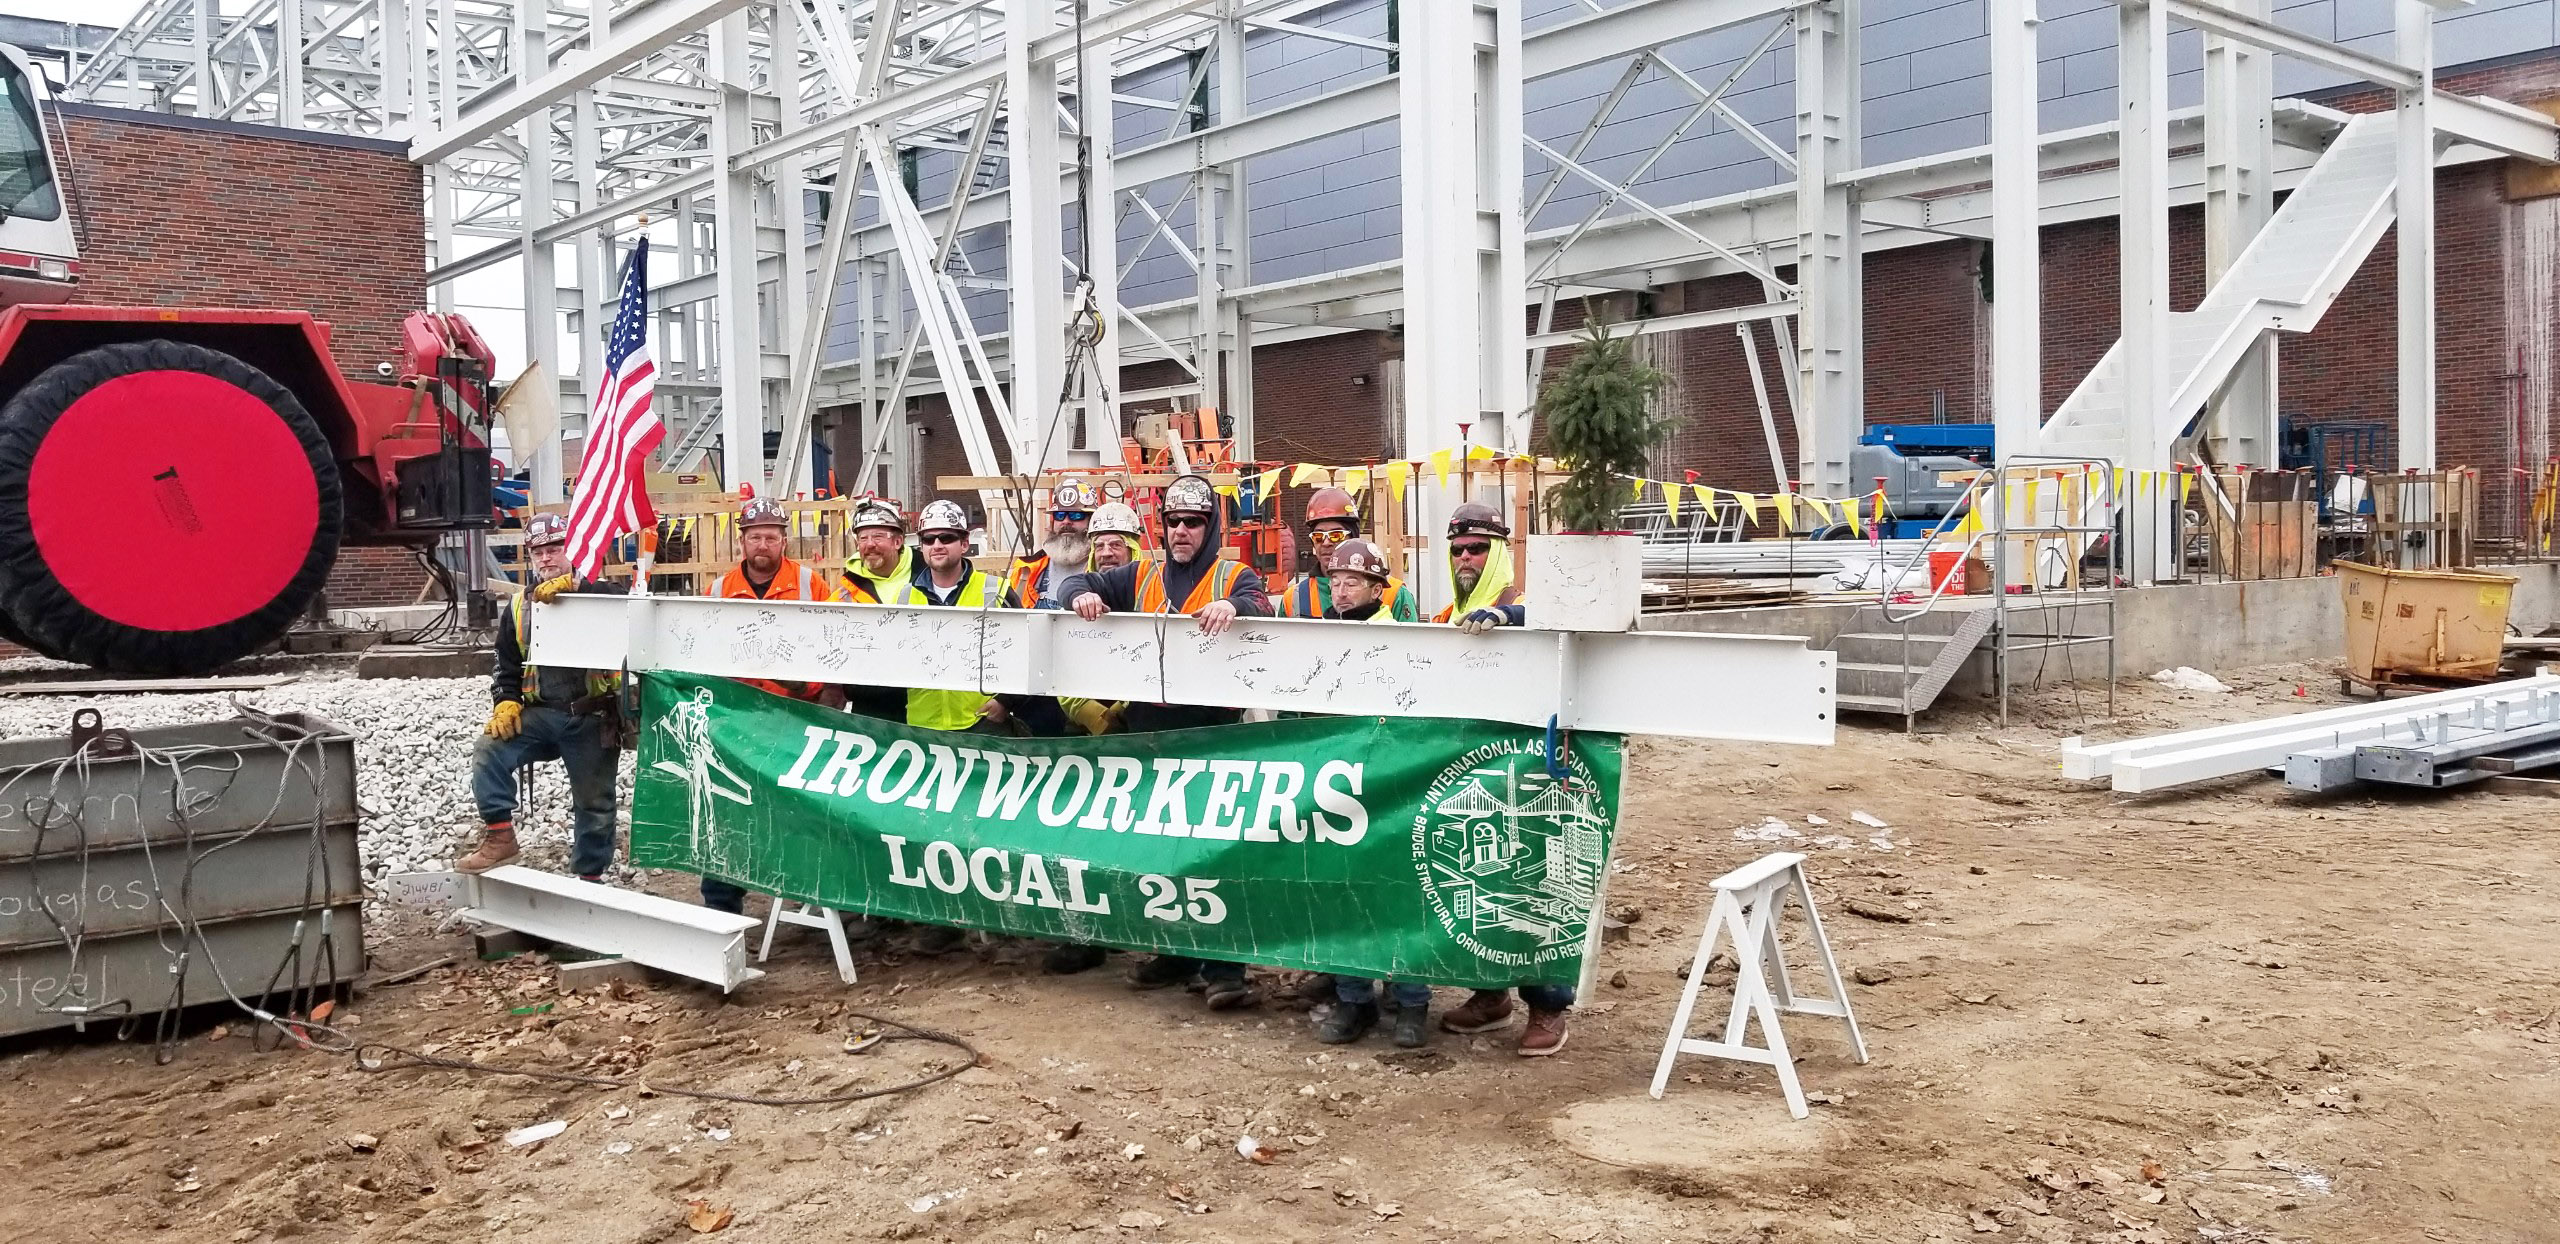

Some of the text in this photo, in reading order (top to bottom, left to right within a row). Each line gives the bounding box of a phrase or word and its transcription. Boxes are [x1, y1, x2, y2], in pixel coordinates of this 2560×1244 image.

[777, 725, 1369, 847] IRONWORKERS
[1424, 738, 1611, 827] INTERNATIONAL ASOCIATION OF
[1411, 815, 1428, 862] BRIDGE,
[881, 833, 1228, 925] LOCAL 25
[1415, 862, 1457, 939] STRUCTURAL,
[1456, 932, 1531, 967] ORNAMENTAL
[1534, 947, 1557, 964] AND
